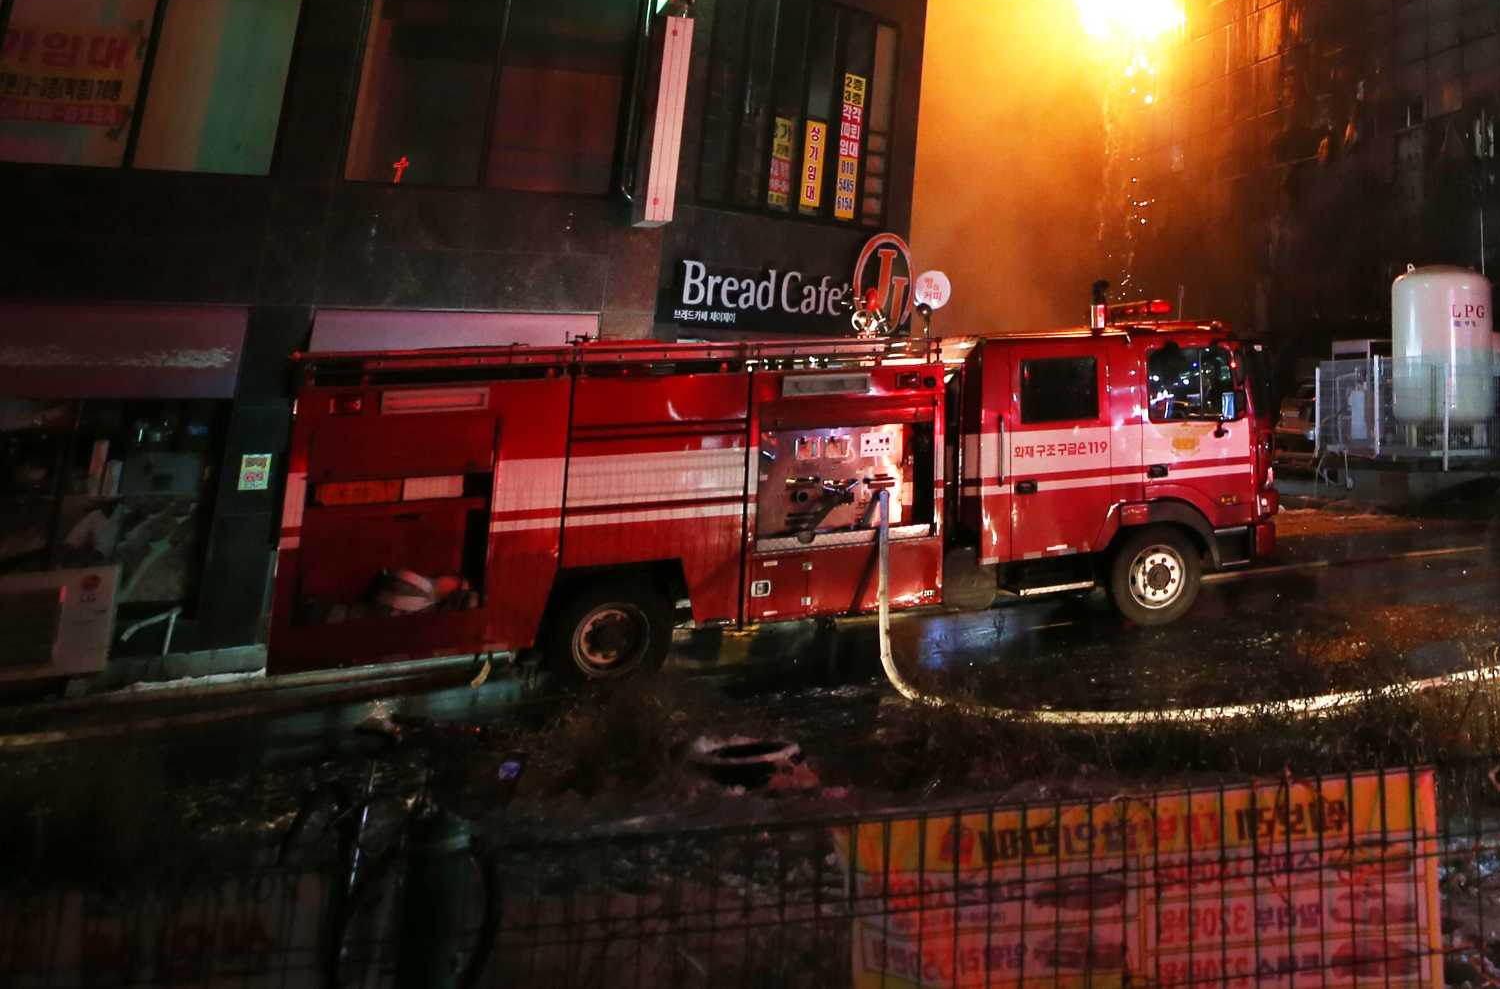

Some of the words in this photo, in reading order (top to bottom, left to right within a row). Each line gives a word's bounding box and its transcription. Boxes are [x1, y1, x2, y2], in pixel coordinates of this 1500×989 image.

[805, 126, 821, 201] 상가임대
[682, 260, 776, 309] Bread
[673, 309, 708, 322] 브레드카페
[1452, 304, 1485, 318] LPG
